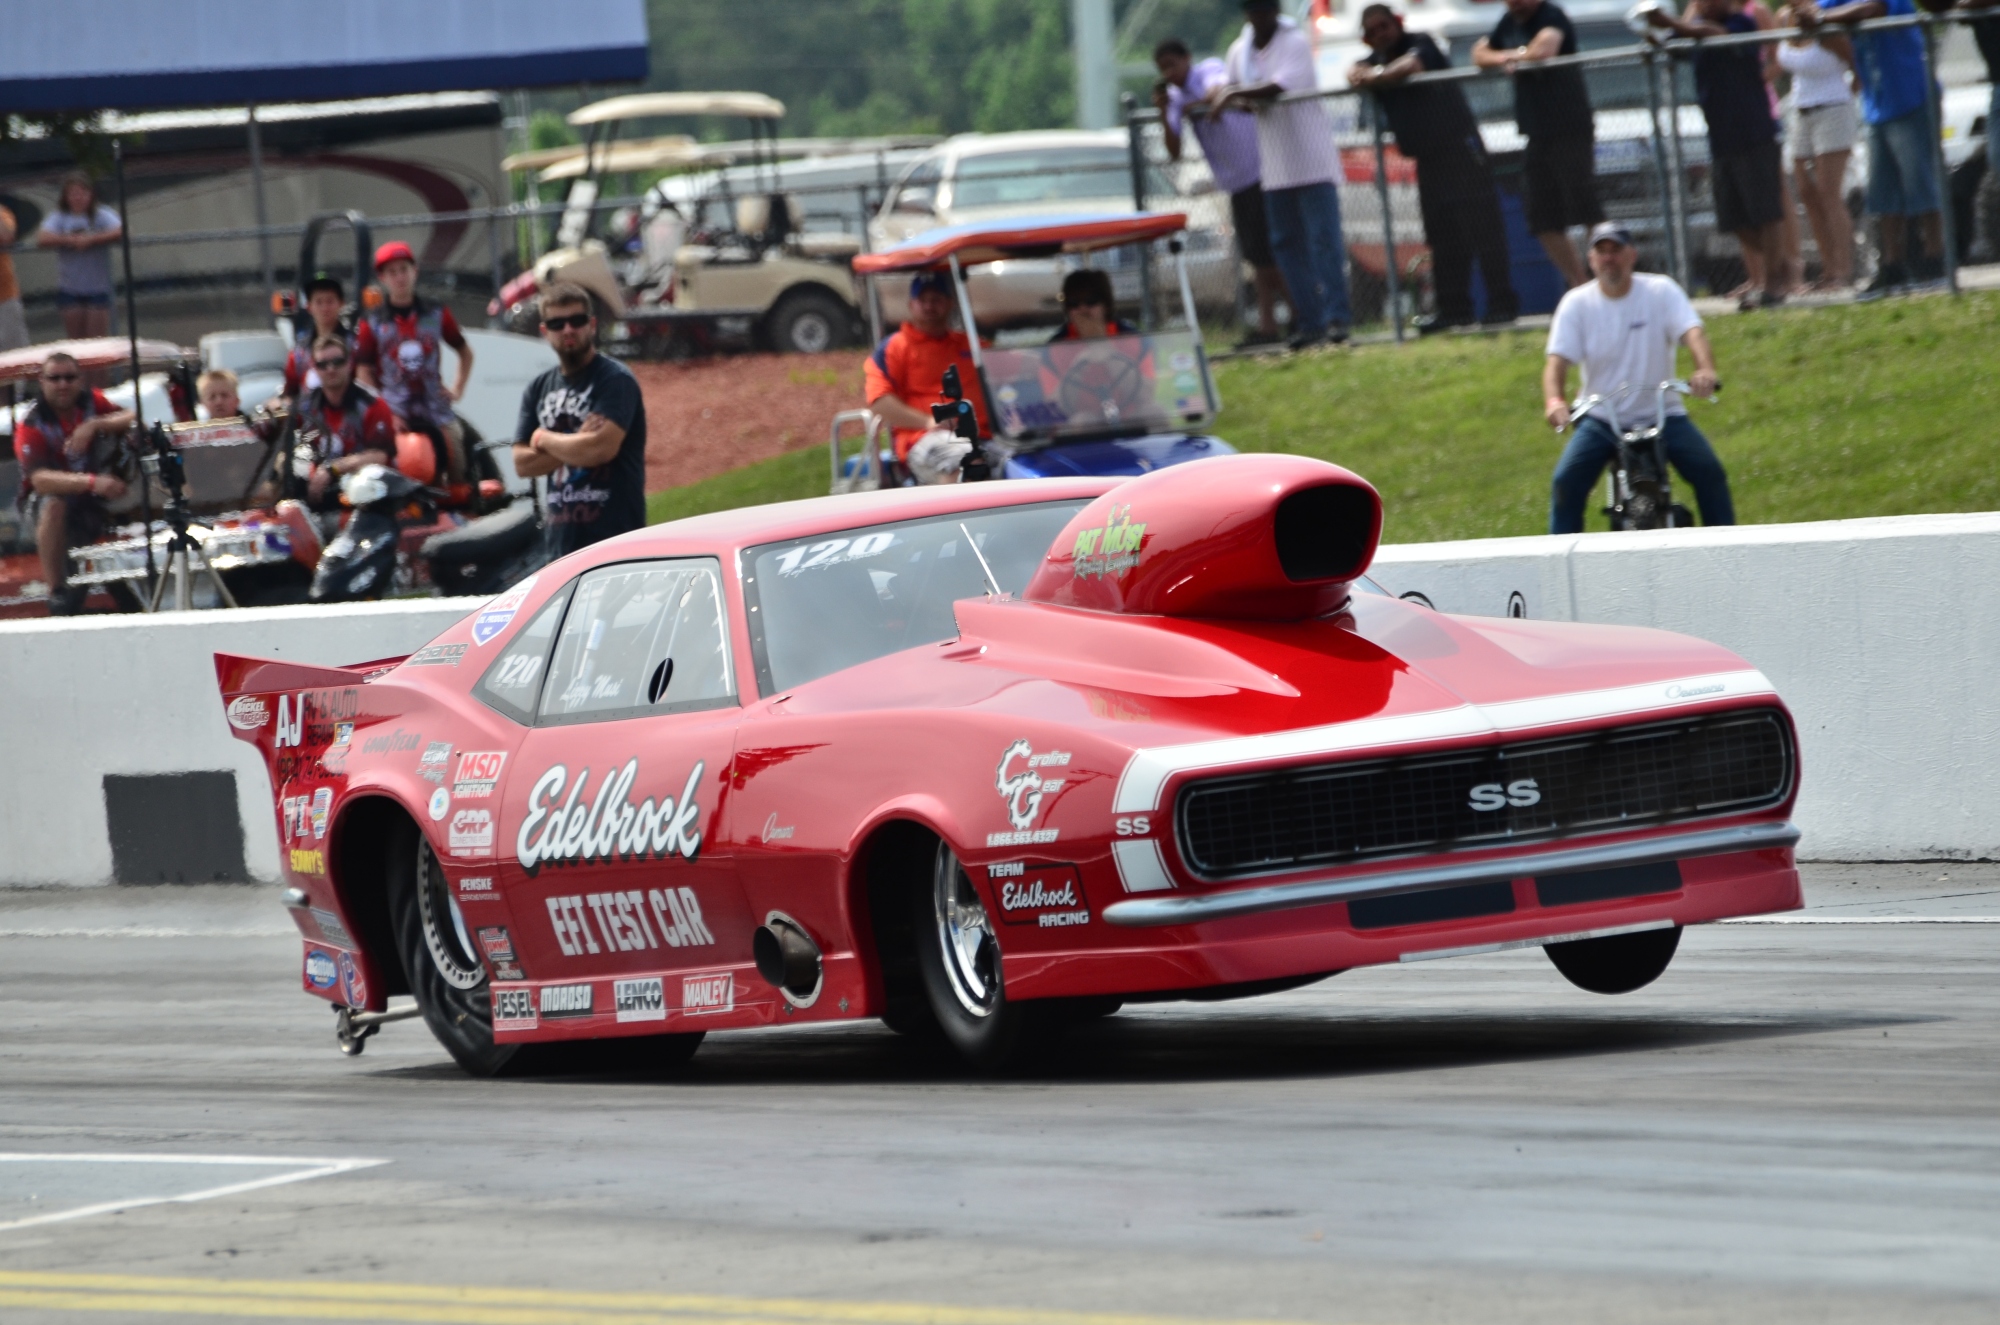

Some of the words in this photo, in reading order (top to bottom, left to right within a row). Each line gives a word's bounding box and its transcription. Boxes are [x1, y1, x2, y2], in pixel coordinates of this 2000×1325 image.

[775, 533, 895, 576] 120
[1072, 527, 1104, 558] PAT
[1099, 523, 1147, 555] MUSI
[495, 653, 543, 684] 120
[331, 688, 358, 718] AUTO
[1664, 683, 1726, 699] Camaro
[275, 692, 304, 749] AJ
[457, 753, 502, 782] MSD
[453, 783, 494, 799] IGNITION
[1468, 778, 1541, 812] SS
[452, 810, 491, 835] GRP
[516, 756, 705, 872] Edelbrock
[1115, 817, 1151, 836] SS
[460, 878, 492, 891] PENSKE
[987, 862, 1025, 878] TEAM
[1002, 879, 1078, 911] Edelbrock
[545, 895, 600, 957] EFI
[586, 890, 659, 953] TEST
[648, 885, 716, 949] CAR
[1039, 911, 1090, 928] RACING
[494, 990, 537, 1019] JESEL
[540, 985, 592, 1013] MOROSO
[616, 980, 663, 1012] LENCO
[684, 977, 729, 1008] MANLEY
